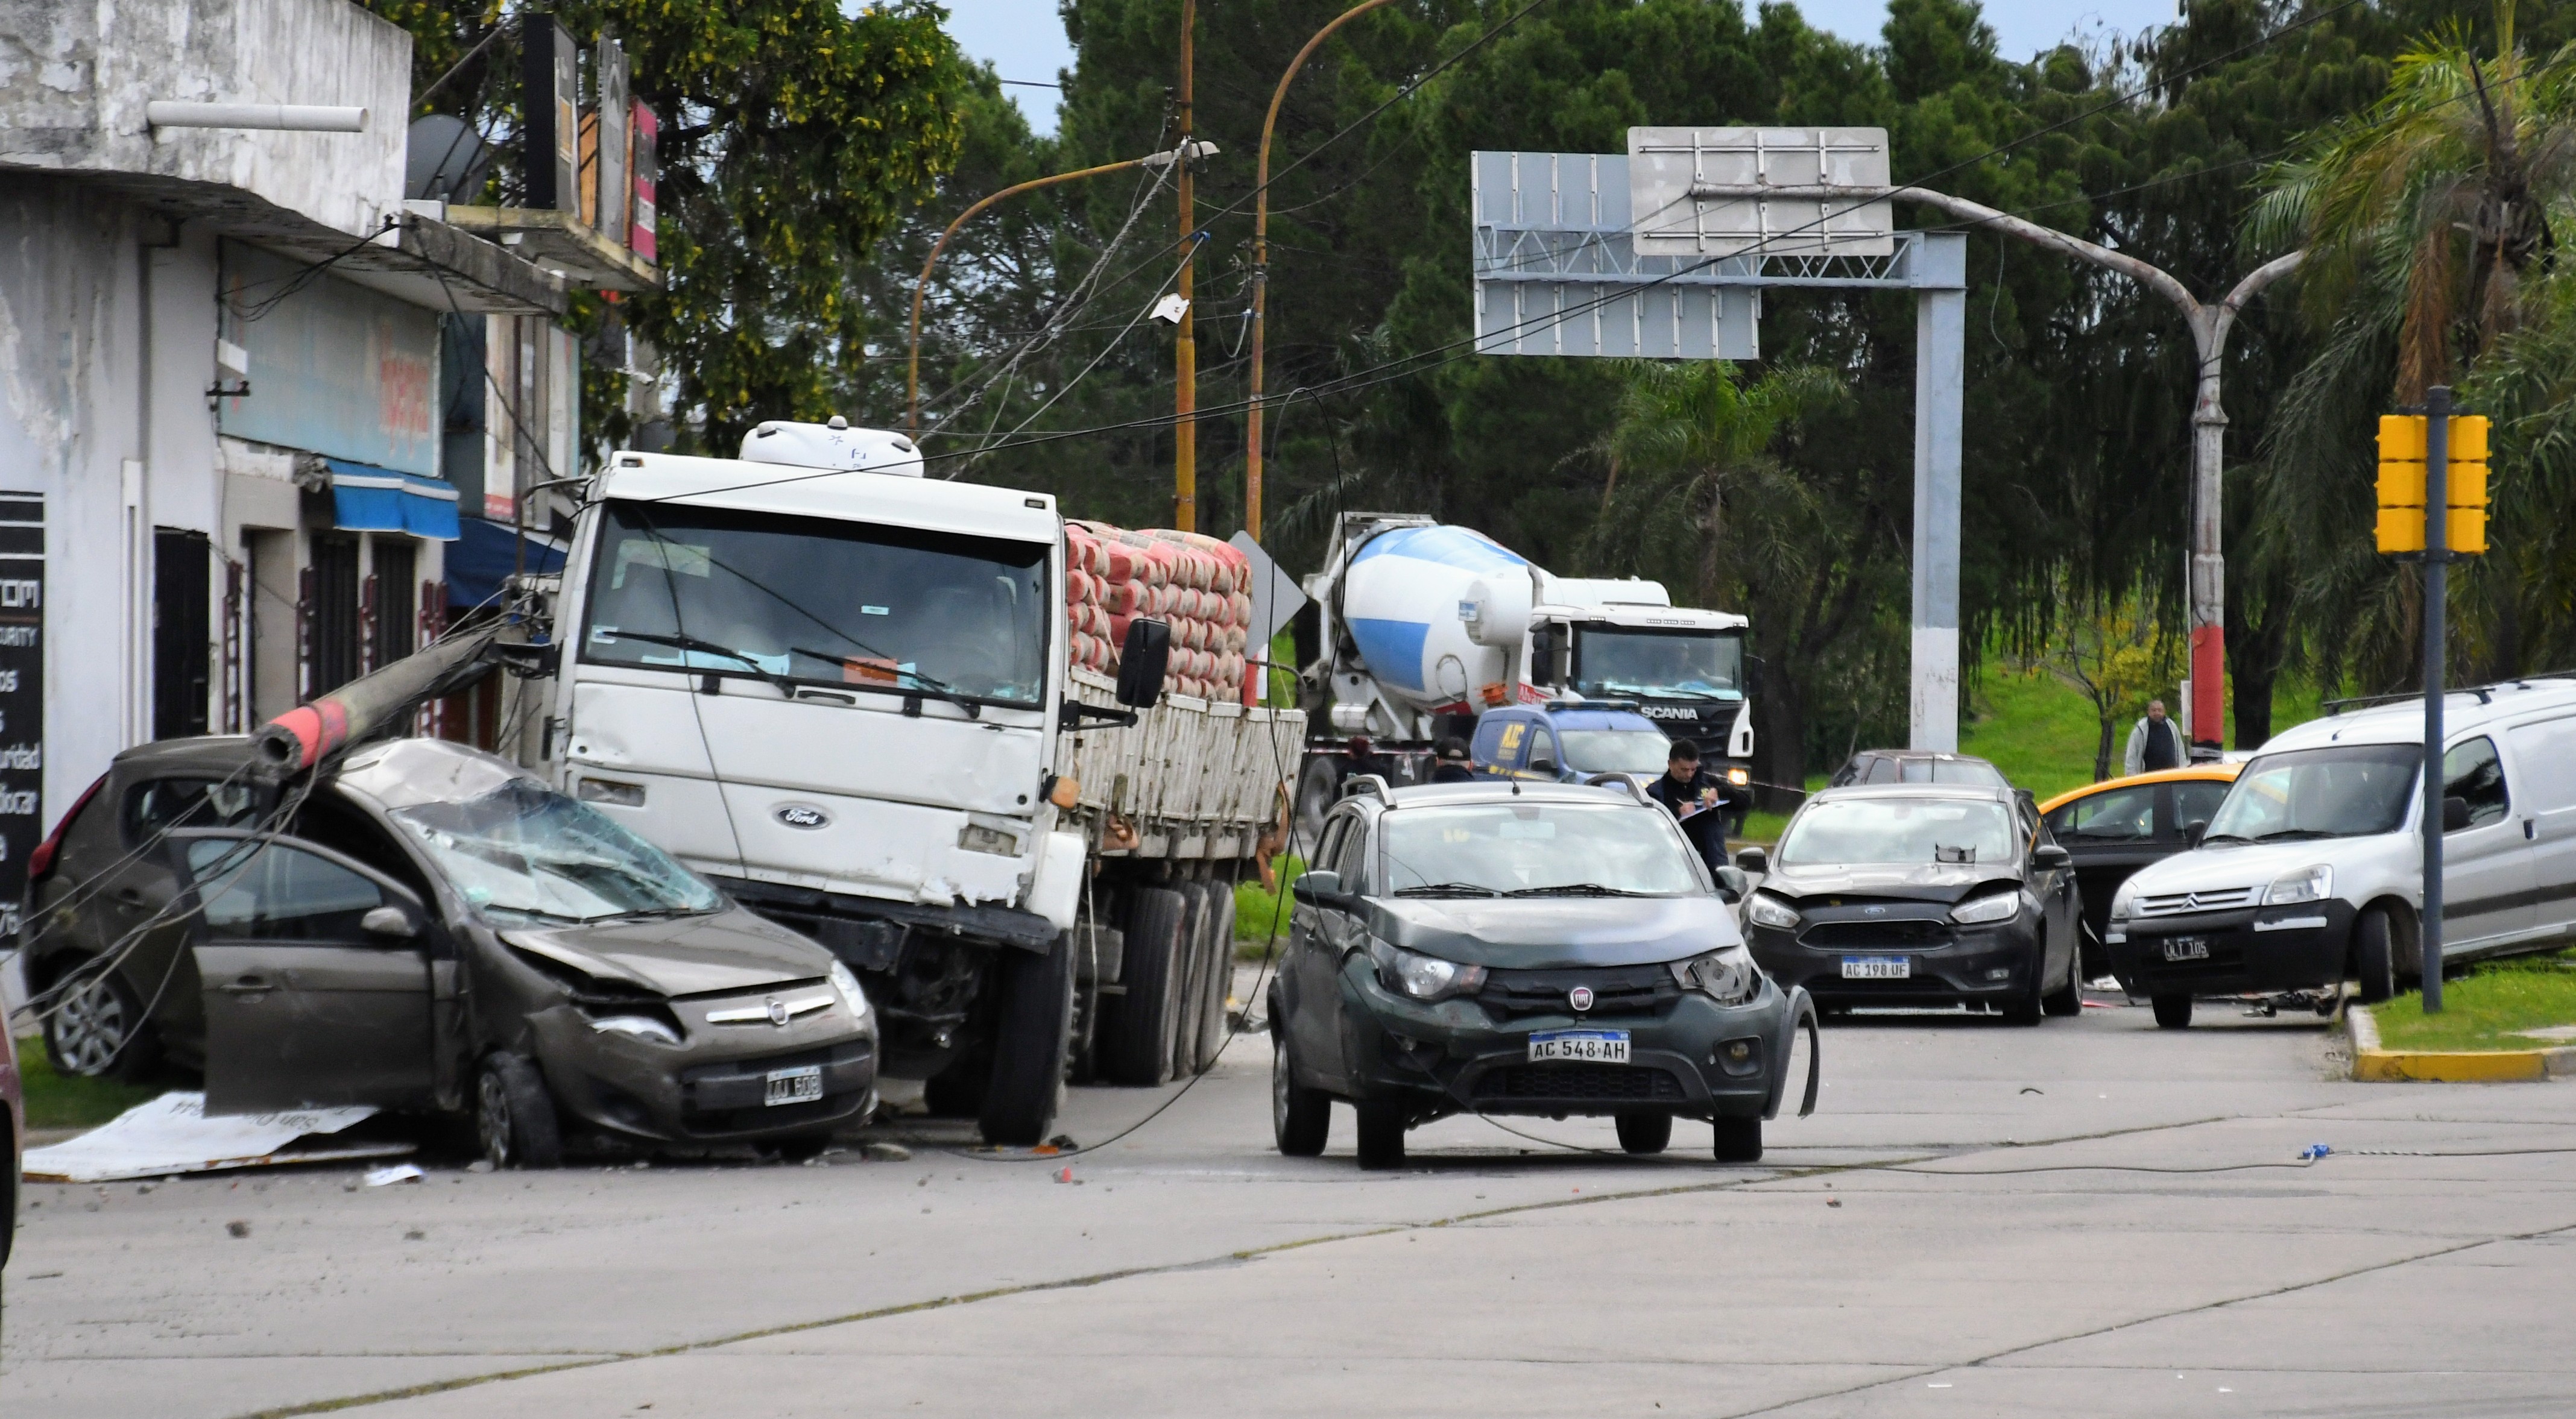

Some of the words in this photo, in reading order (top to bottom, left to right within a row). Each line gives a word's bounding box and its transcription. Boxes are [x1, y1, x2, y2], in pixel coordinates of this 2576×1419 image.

[0, 579, 40, 608] OM
[1641, 706, 1699, 720] SCANIA
[786, 809, 819, 825] Ford
[2189, 942, 2207, 955] 105
[1846, 964, 1860, 977] AC
[1865, 964, 1887, 977] 198
[1892, 964, 1907, 977] UF
[1574, 993, 1589, 1005] FIAT
[1535, 1042, 1555, 1058] AC
[1563, 1041, 1596, 1057] 548
[1603, 1042, 1624, 1059] AH
